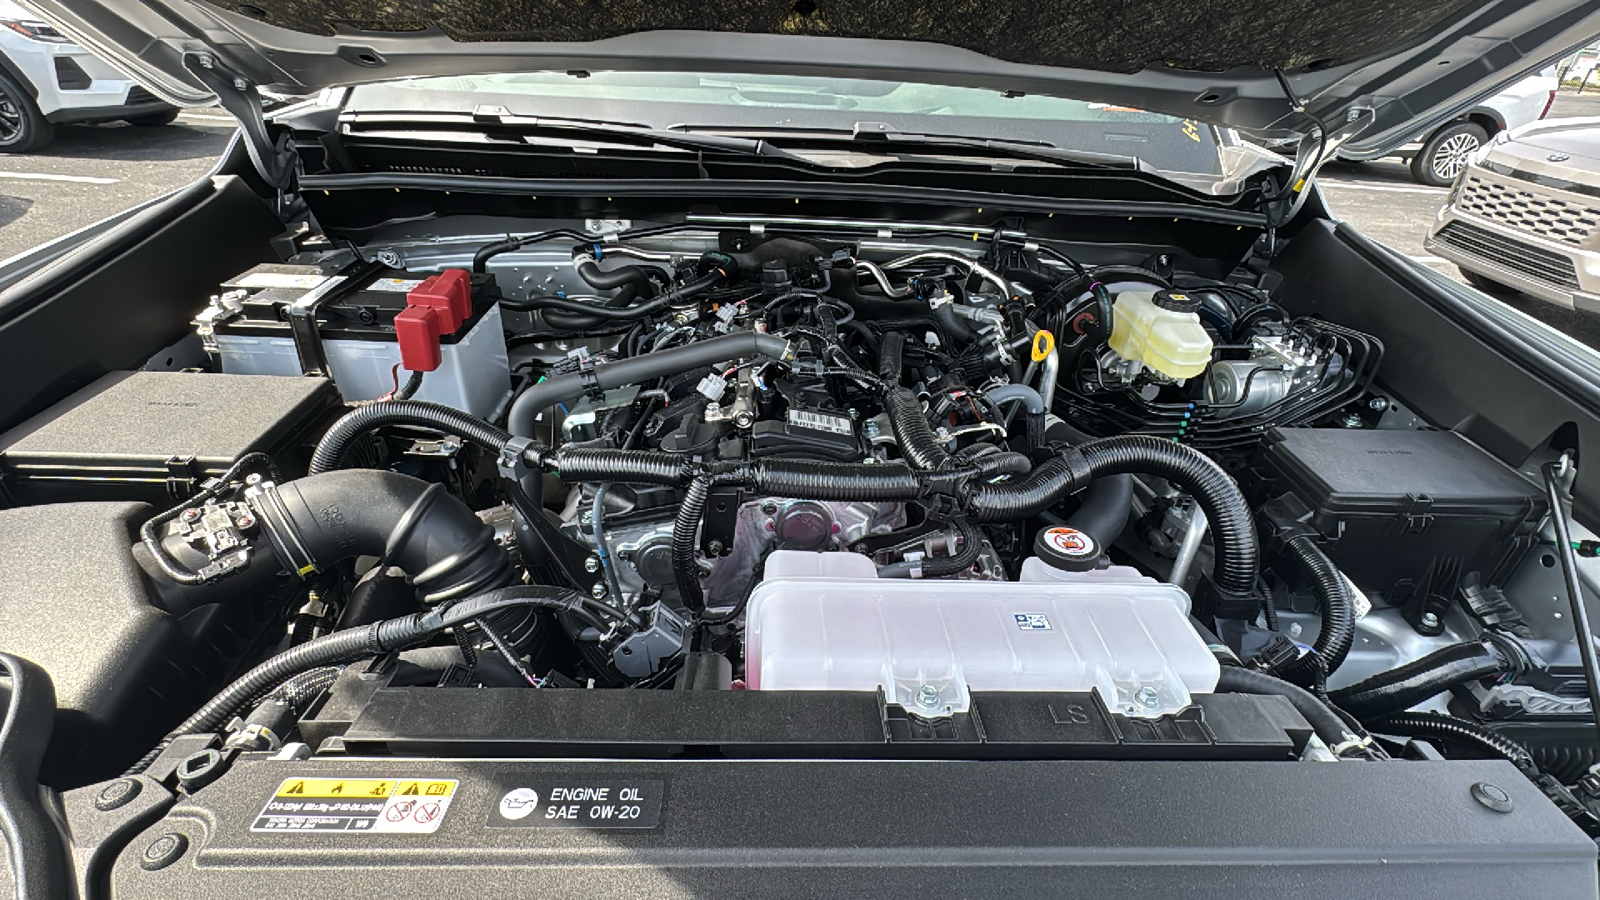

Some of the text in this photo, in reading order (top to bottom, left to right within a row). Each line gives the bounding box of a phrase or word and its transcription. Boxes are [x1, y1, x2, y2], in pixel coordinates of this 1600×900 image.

[1047, 704, 1090, 724] LS
[550, 787, 644, 801] ENGINE OIL
[545, 805, 641, 819] SAE 0W-20
